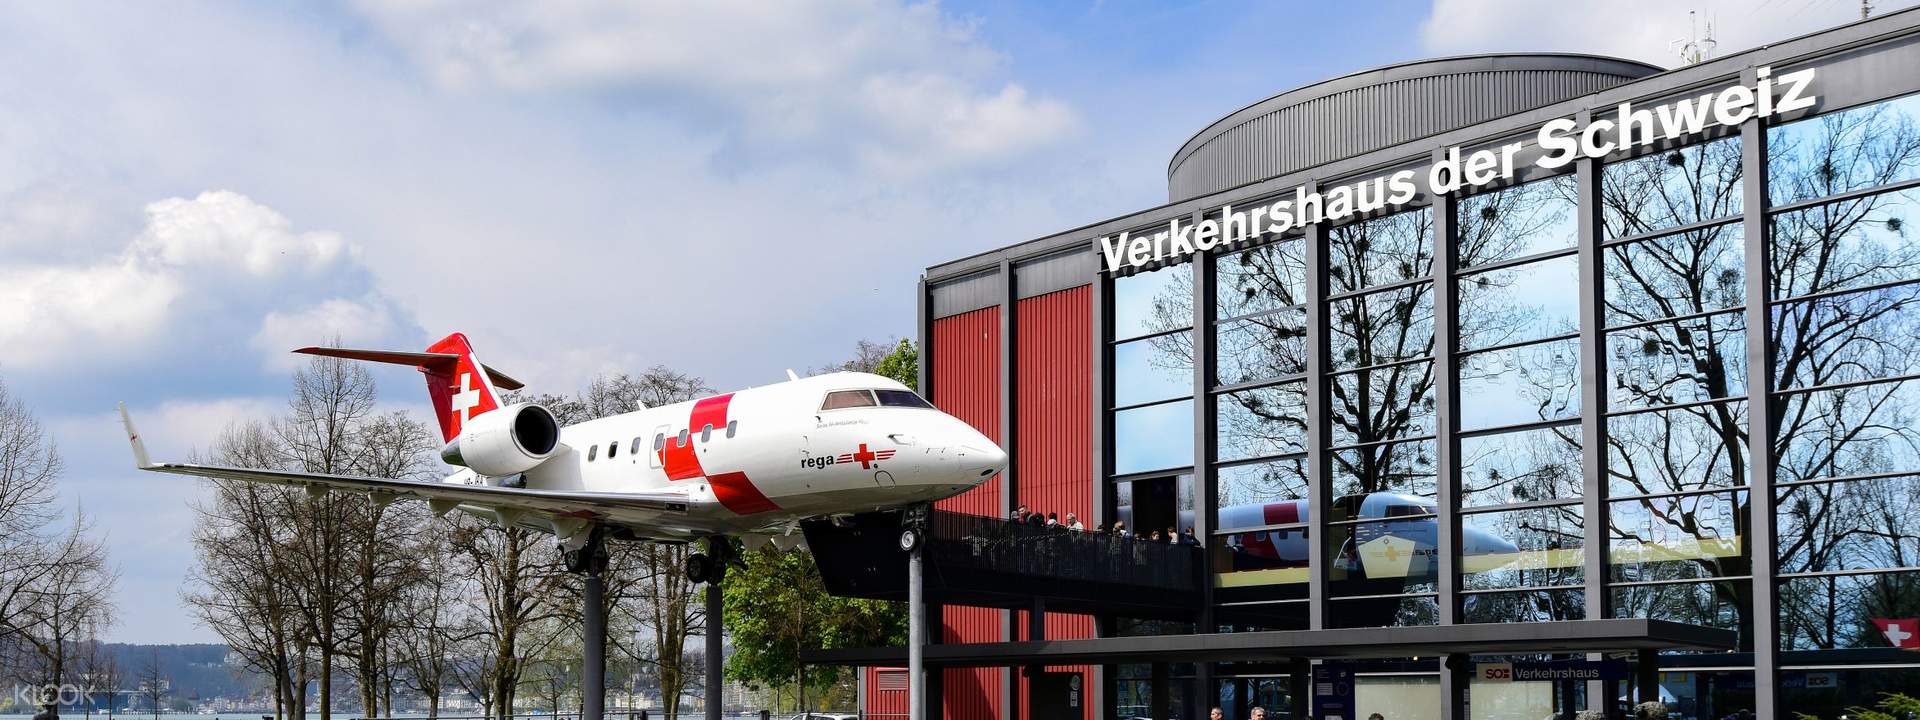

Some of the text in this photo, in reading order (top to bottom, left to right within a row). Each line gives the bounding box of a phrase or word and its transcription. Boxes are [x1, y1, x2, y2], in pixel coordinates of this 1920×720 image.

[1100, 66, 1816, 273] Verkehrshaus der Schweiz
[800, 454, 835, 470] rega
[1514, 667, 1600, 680] Verkehrshaus
